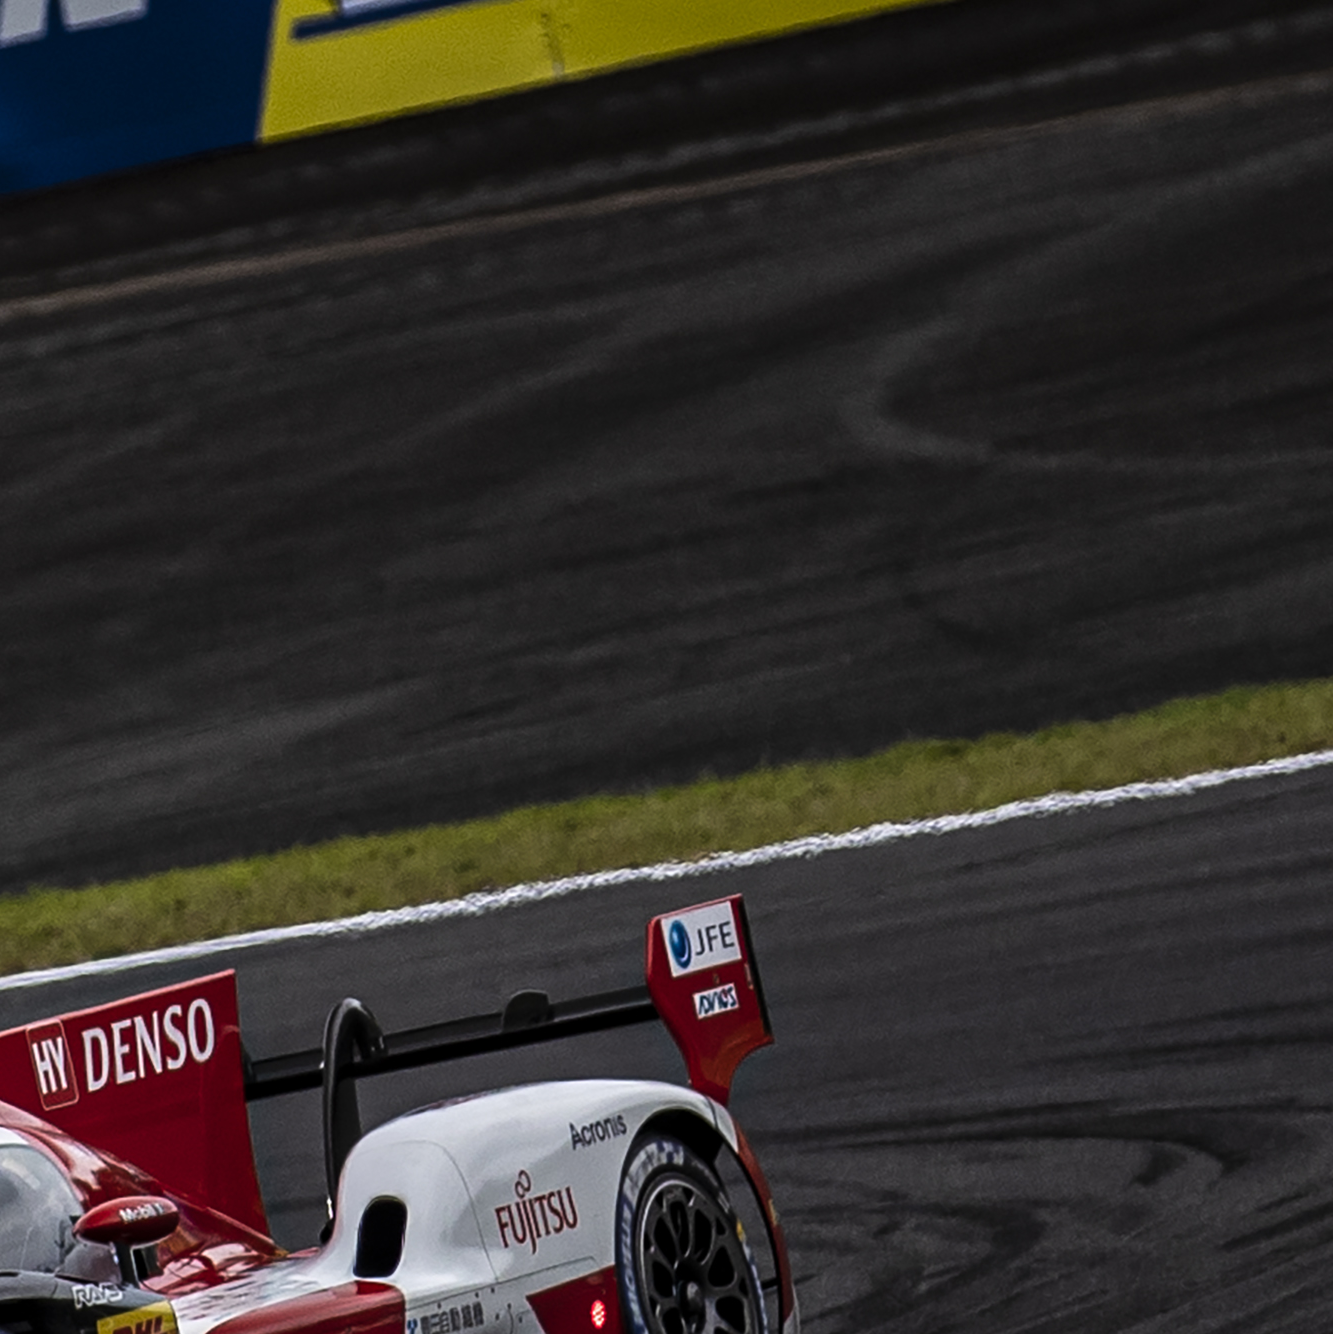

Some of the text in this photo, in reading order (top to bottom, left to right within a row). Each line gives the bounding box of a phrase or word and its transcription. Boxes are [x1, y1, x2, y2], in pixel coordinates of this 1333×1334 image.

[695, 921, 735, 956] JFE
[32, 998, 215, 1095] HY DENSO
[569, 1114, 628, 1150] Acronis
[494, 1186, 579, 1256] FUJITSU
